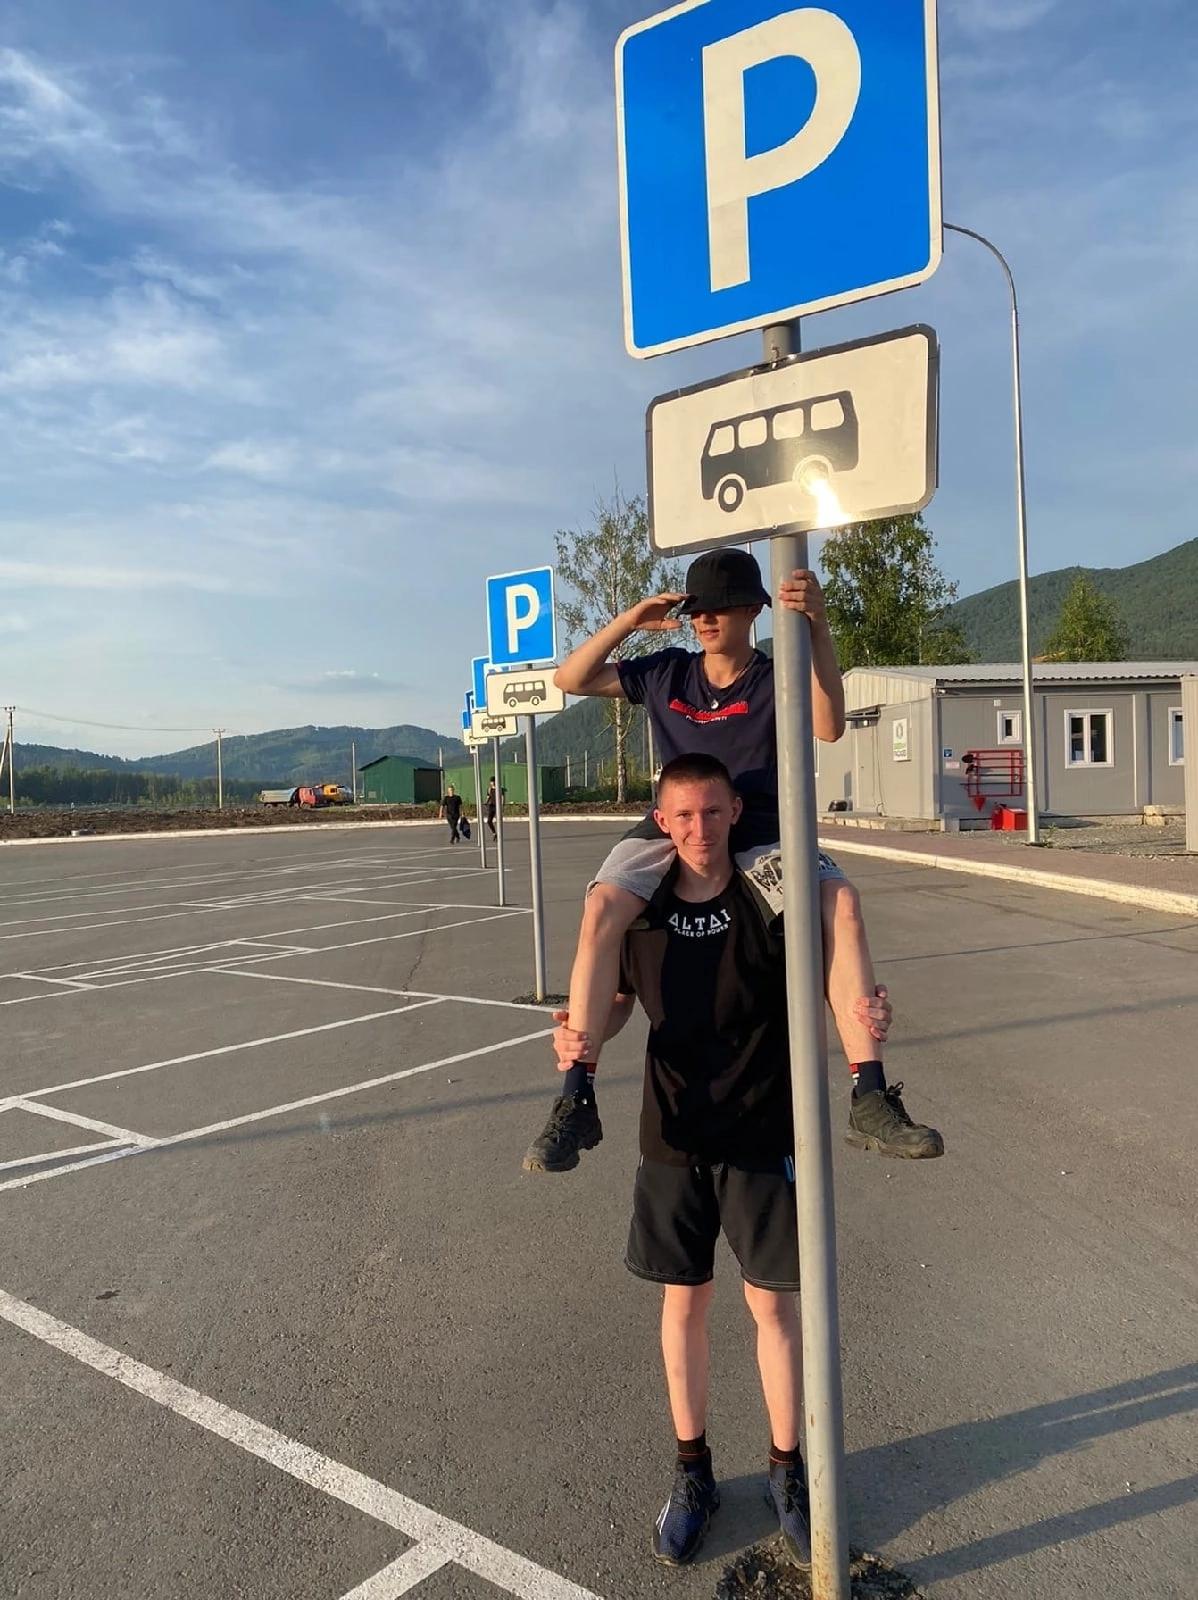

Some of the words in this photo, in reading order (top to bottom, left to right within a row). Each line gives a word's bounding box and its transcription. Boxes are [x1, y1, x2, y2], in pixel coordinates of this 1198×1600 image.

[702, 7, 862, 293] P
[506, 583, 541, 654] P
[668, 908, 731, 930] ALTAI
[696, 930, 705, 938] OF
